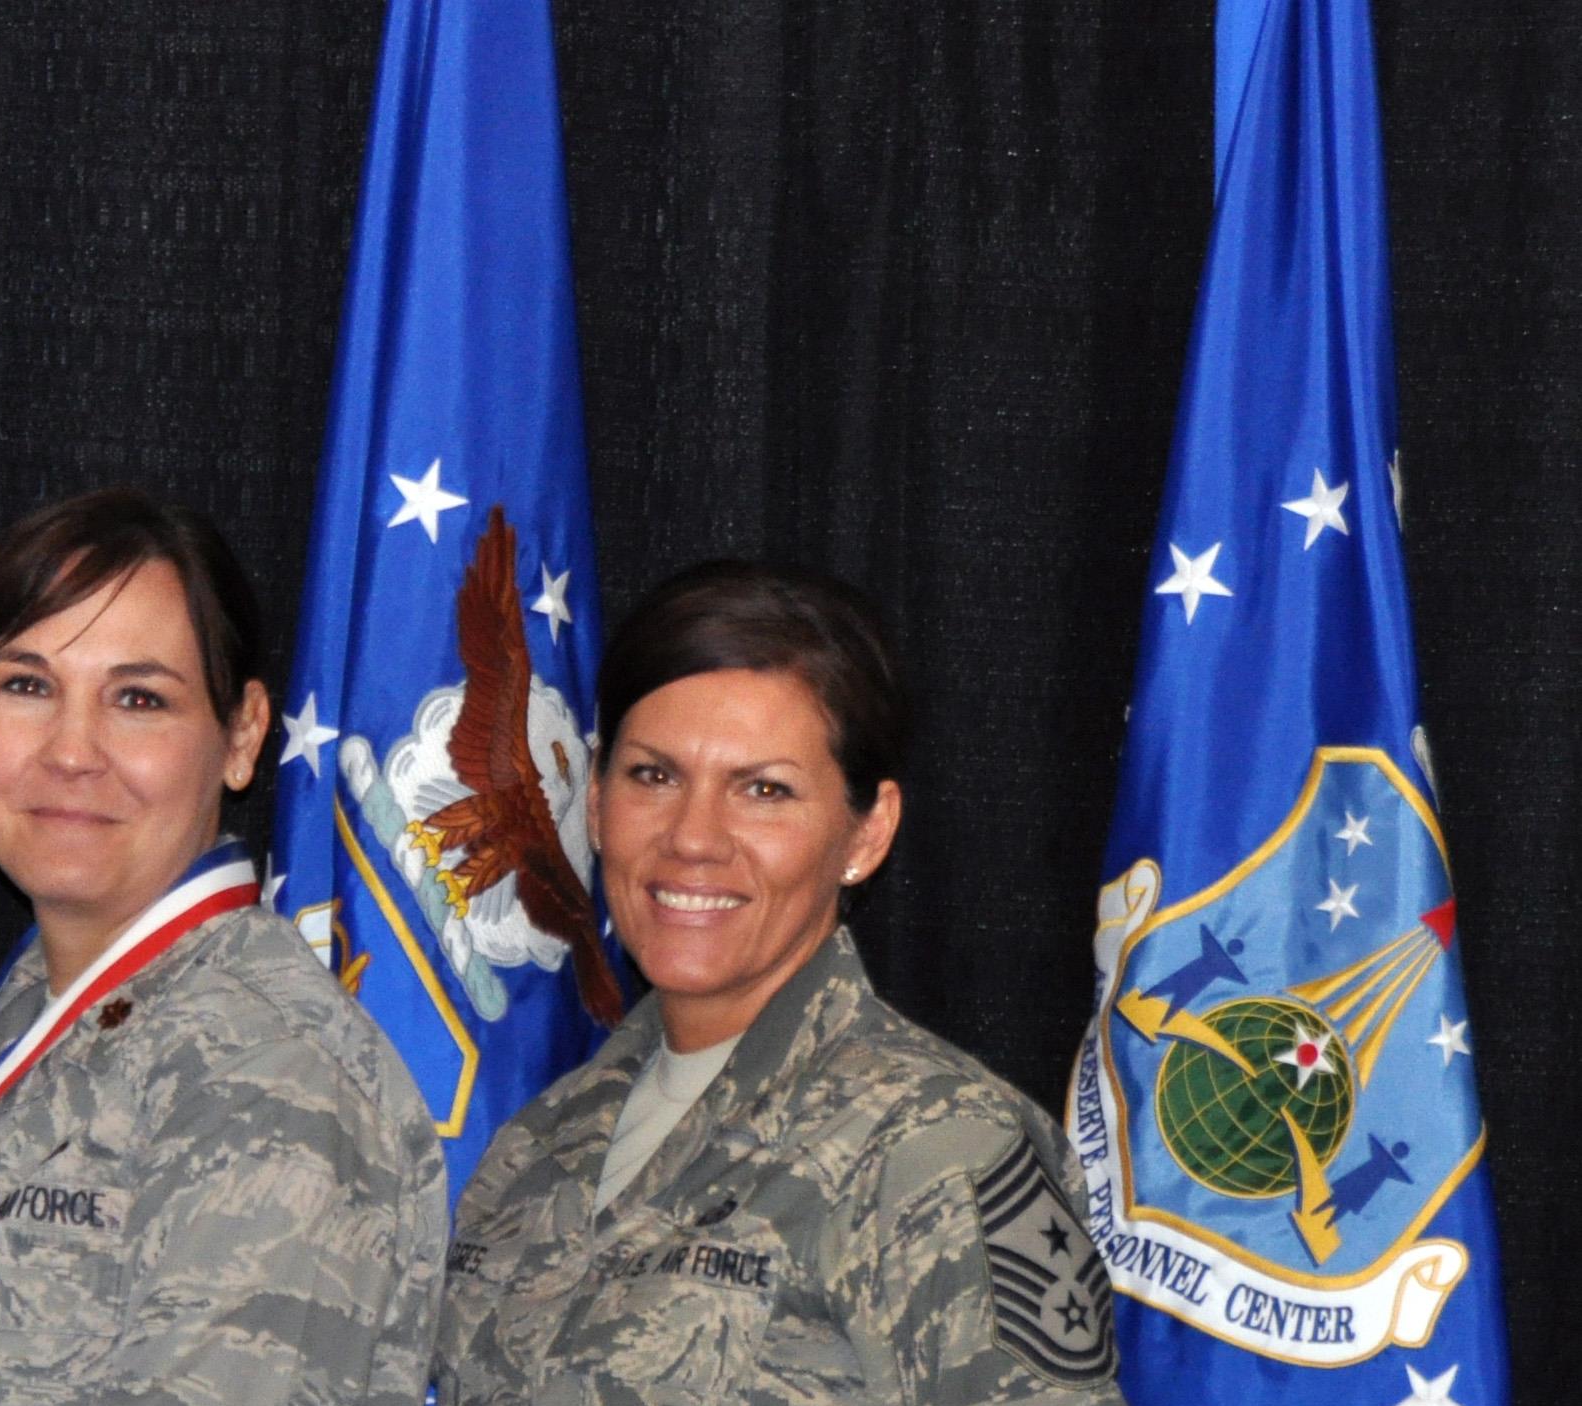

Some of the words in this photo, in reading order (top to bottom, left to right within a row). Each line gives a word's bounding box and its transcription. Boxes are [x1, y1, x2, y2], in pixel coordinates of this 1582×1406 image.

[16, 1184, 107, 1229] FORCE
[692, 1245, 771, 1289] FORCE
[1089, 1177, 1212, 1307] PERSONNEL
[1224, 1282, 1356, 1344] CENTER
